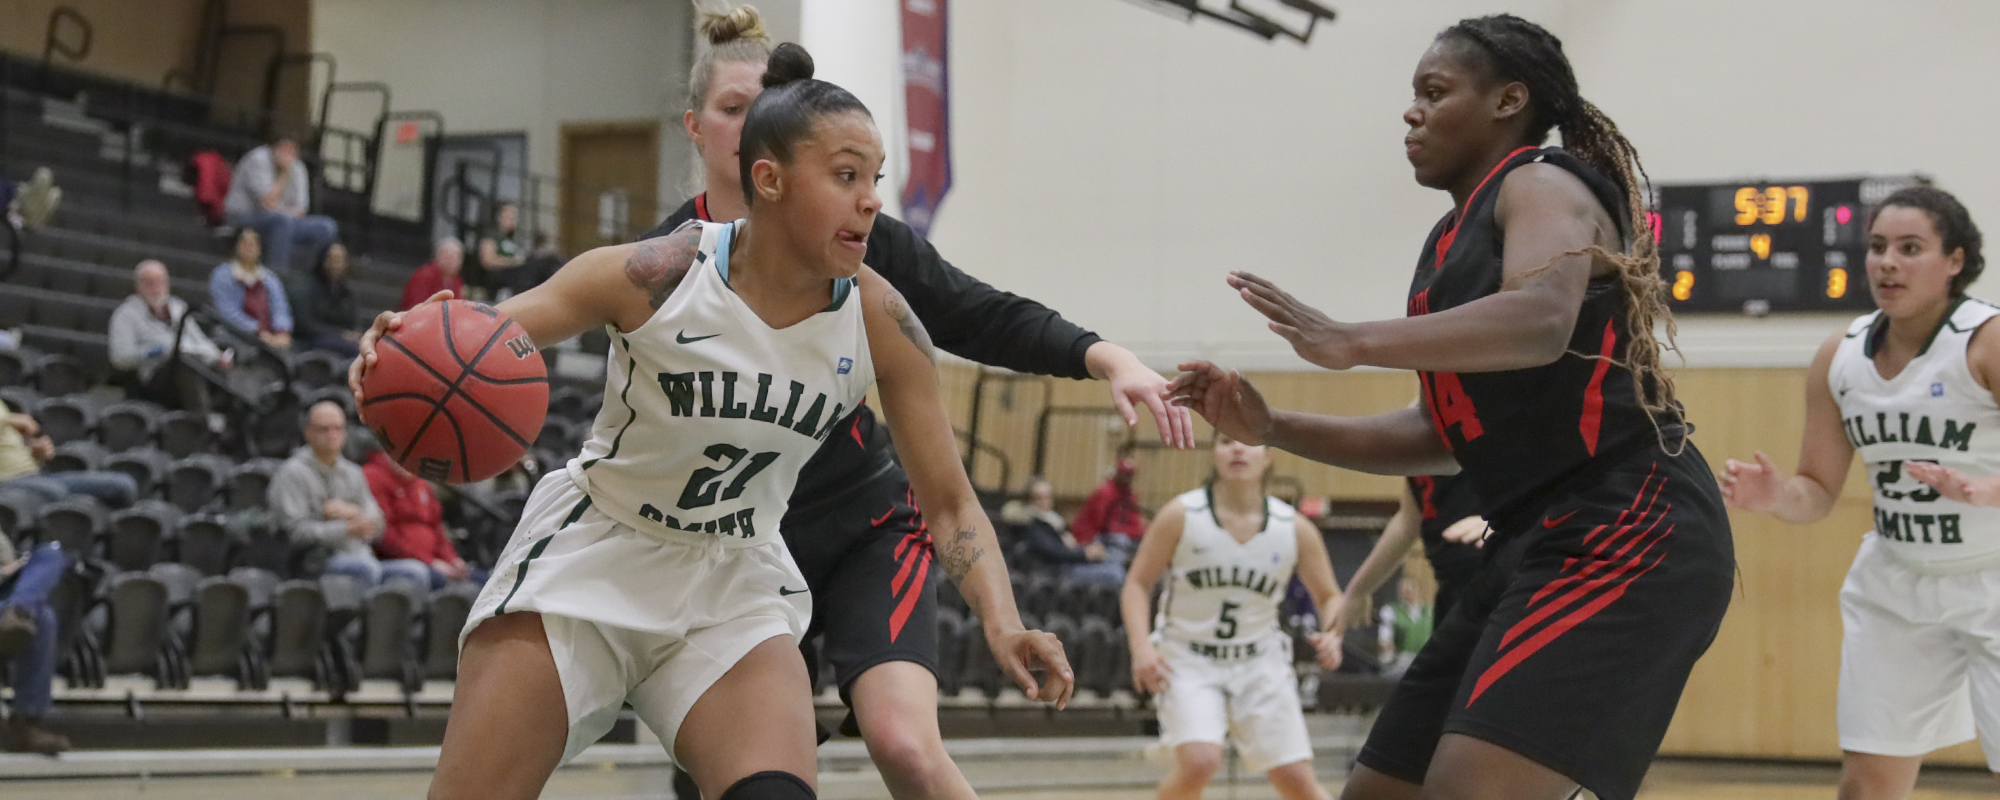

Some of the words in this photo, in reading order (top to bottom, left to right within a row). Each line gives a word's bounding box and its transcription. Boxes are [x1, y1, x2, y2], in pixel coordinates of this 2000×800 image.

[1734, 186, 1808, 226] 5:37
[1845, 412, 1977, 452] ILLIAM
[676, 443, 781, 510] 21
[1215, 601, 1240, 639] 5
